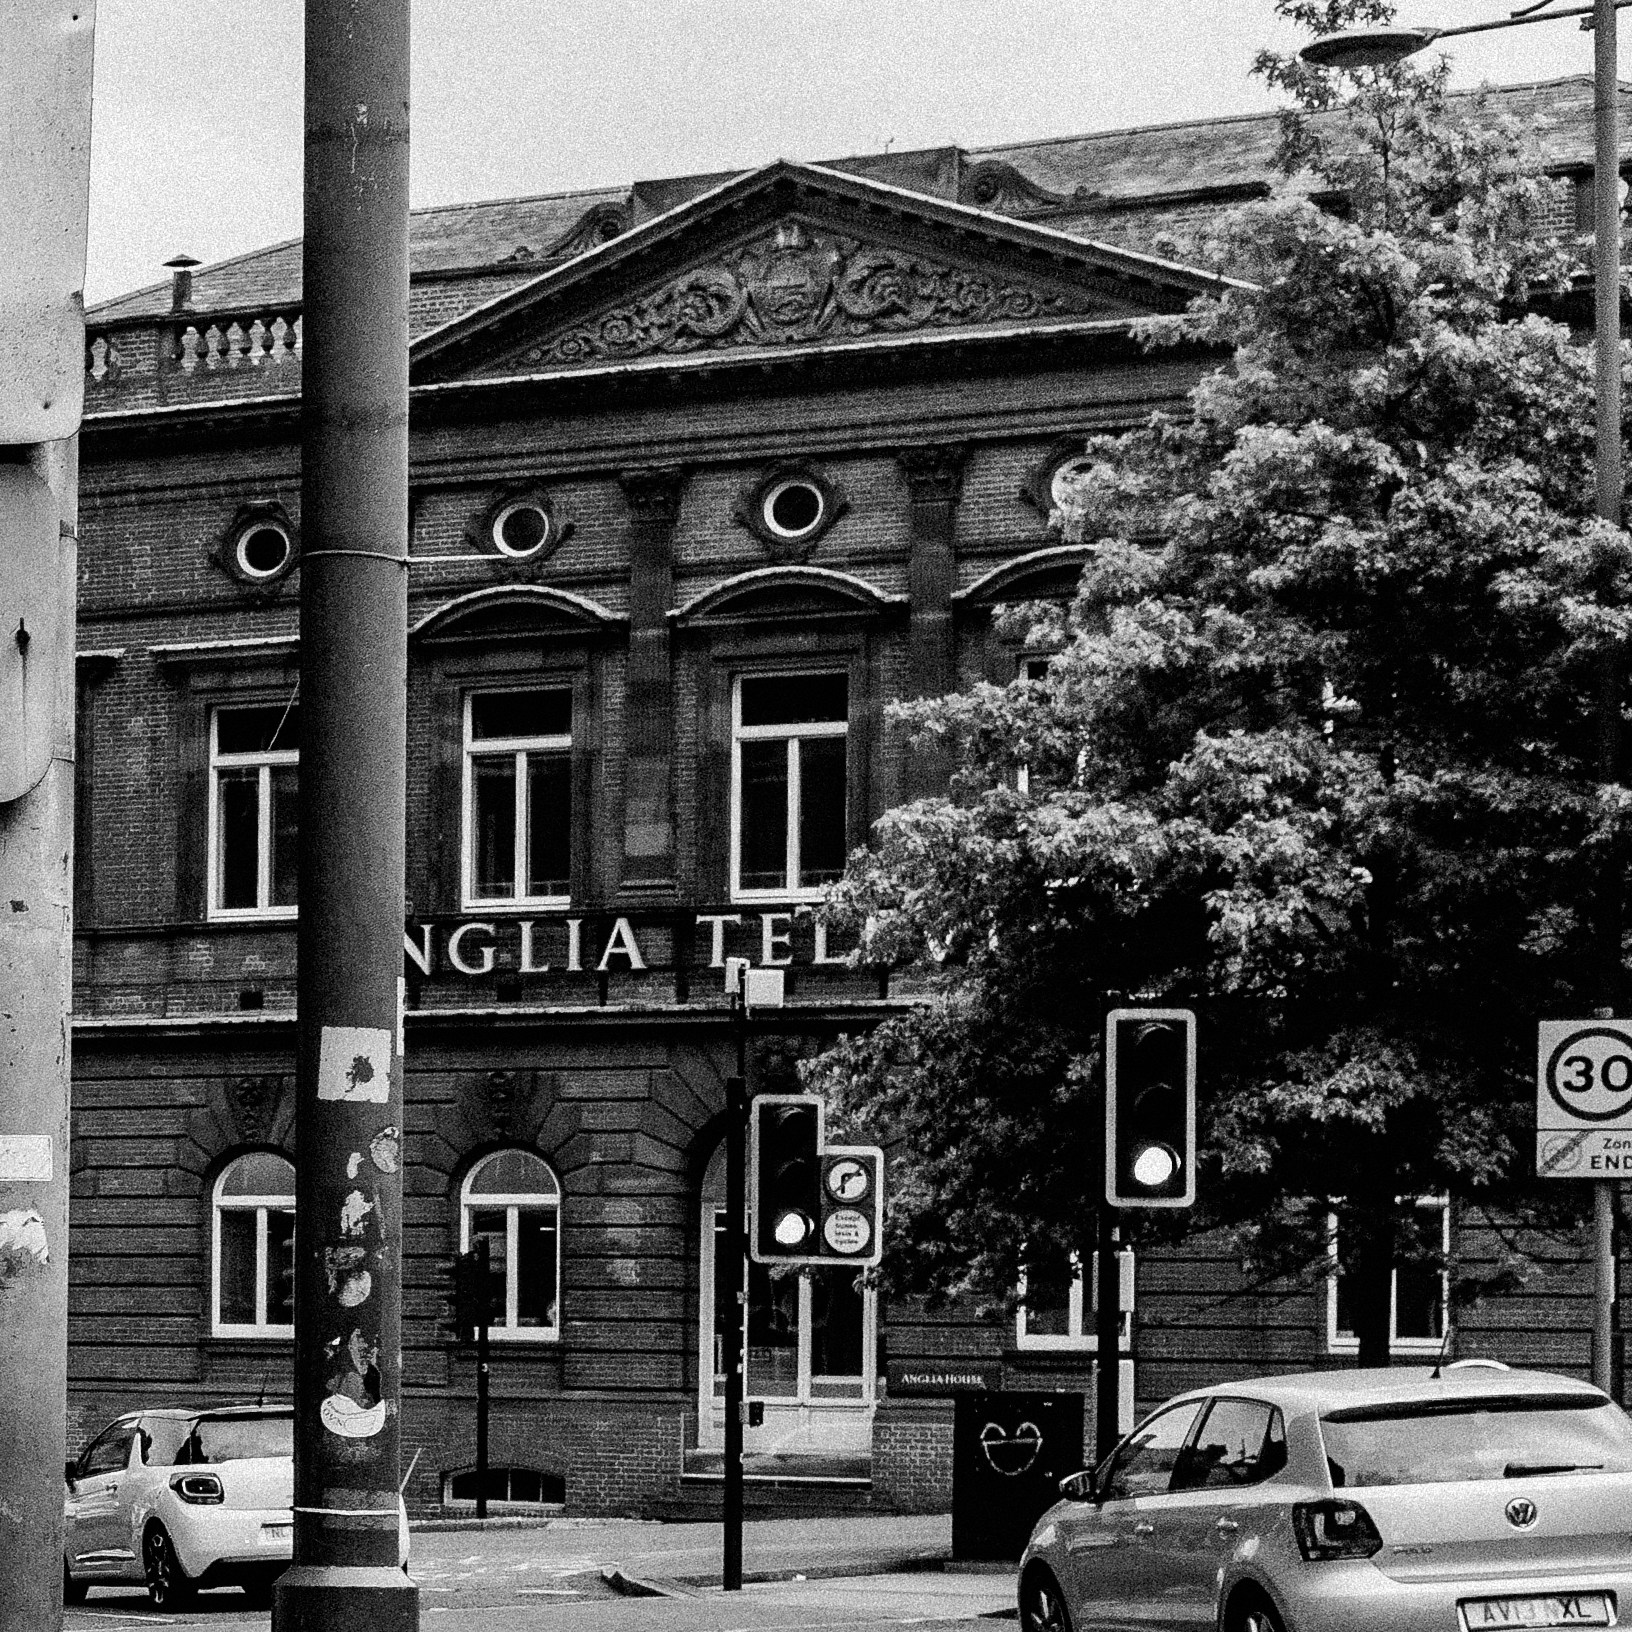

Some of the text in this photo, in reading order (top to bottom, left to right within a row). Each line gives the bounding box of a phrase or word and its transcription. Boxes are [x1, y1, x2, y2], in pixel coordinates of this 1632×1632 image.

[1563, 1054, 1632, 1093] 30
[1591, 1155, 1632, 1169] END
[901, 1374, 944, 1384] ANGLIA
